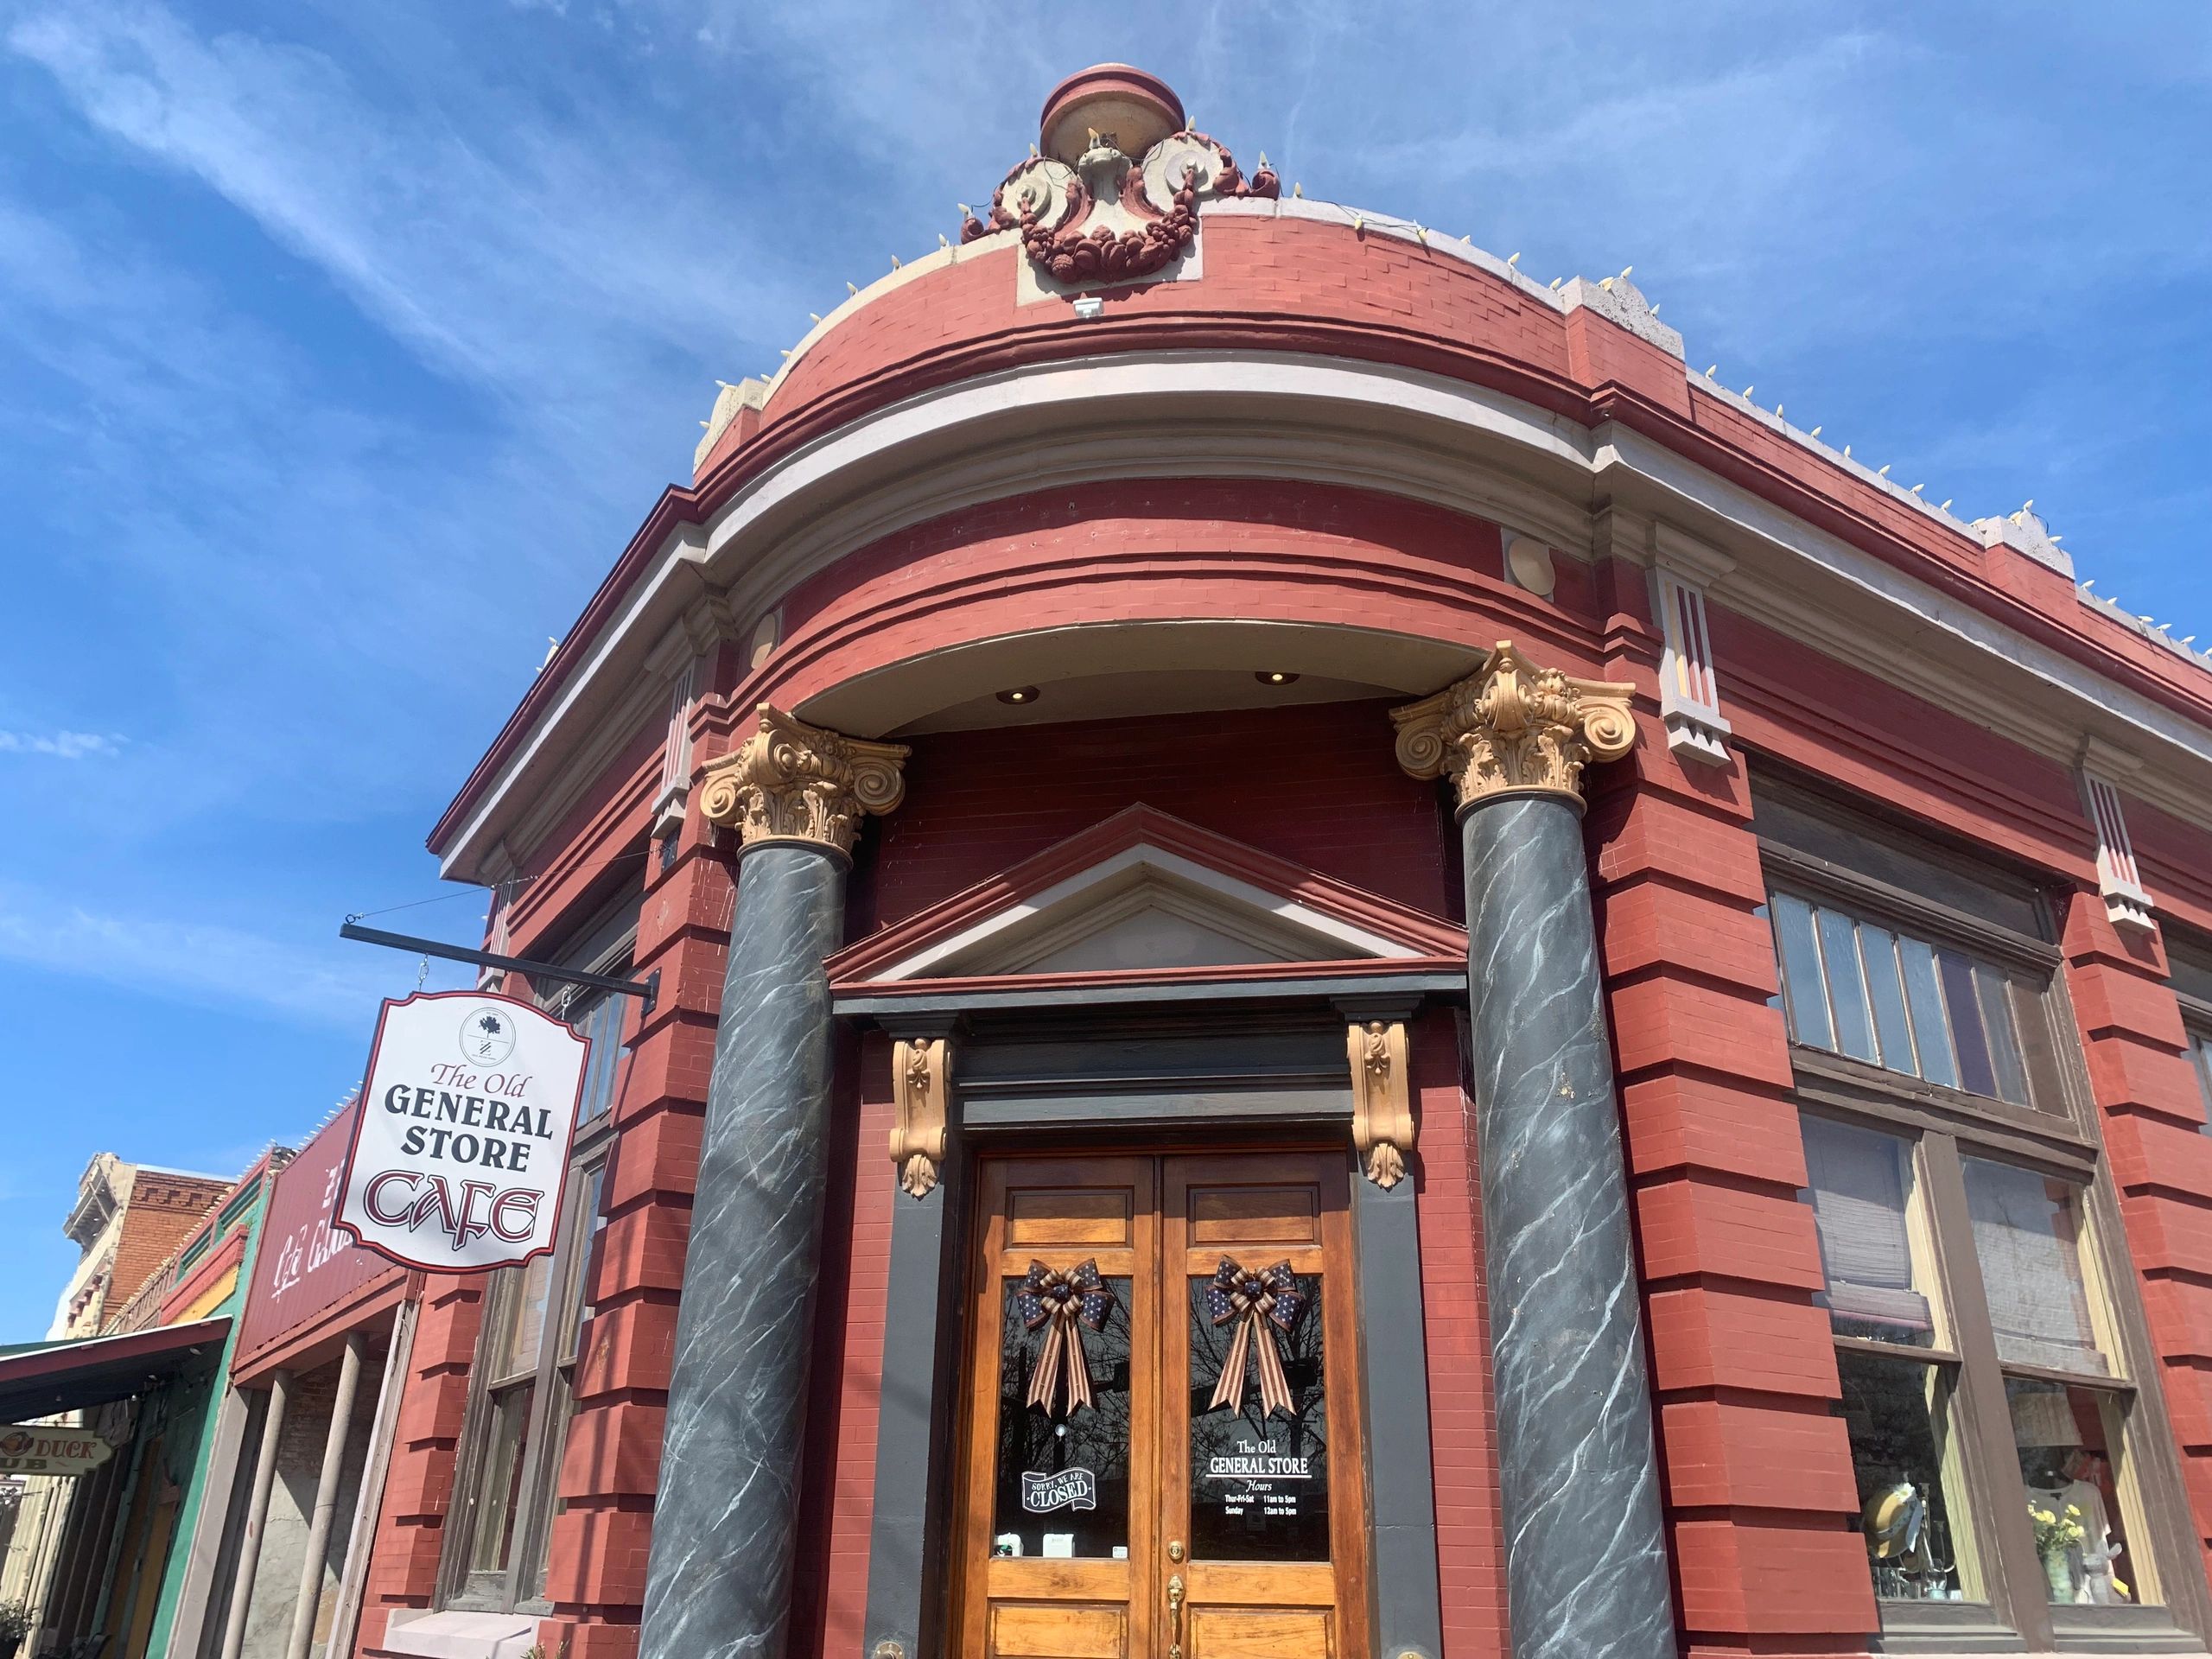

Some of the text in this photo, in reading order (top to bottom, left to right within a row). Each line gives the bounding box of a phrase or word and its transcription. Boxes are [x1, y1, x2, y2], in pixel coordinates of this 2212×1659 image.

[430, 1063, 533, 1098] The Old
[385, 1084, 553, 1141] GENERAL
[400, 1125, 531, 1173] STORE
[363, 1169, 545, 1251] CAFE
[35, 1440, 97, 1459] DUCK
[1236, 1440, 1277, 1453] The Old
[0, 1458, 48, 1470] UB
[1210, 1457, 1308, 1474] GENERAL STORE
[1058, 1474, 1069, 1484] WE
[1070, 1472, 1084, 1481] ARE
[1245, 1479, 1273, 1493] Hours
[1030, 1480, 1088, 1507] CLOSED
[1263, 1495, 1278, 1503] 11am
[1278, 1495, 1284, 1503] to
[1285, 1495, 1297, 1504] 5pm
[1225, 1506, 1244, 1516] Sunday
[1279, 1507, 1285, 1516] to
[1285, 1506, 1297, 1516] 5pm
